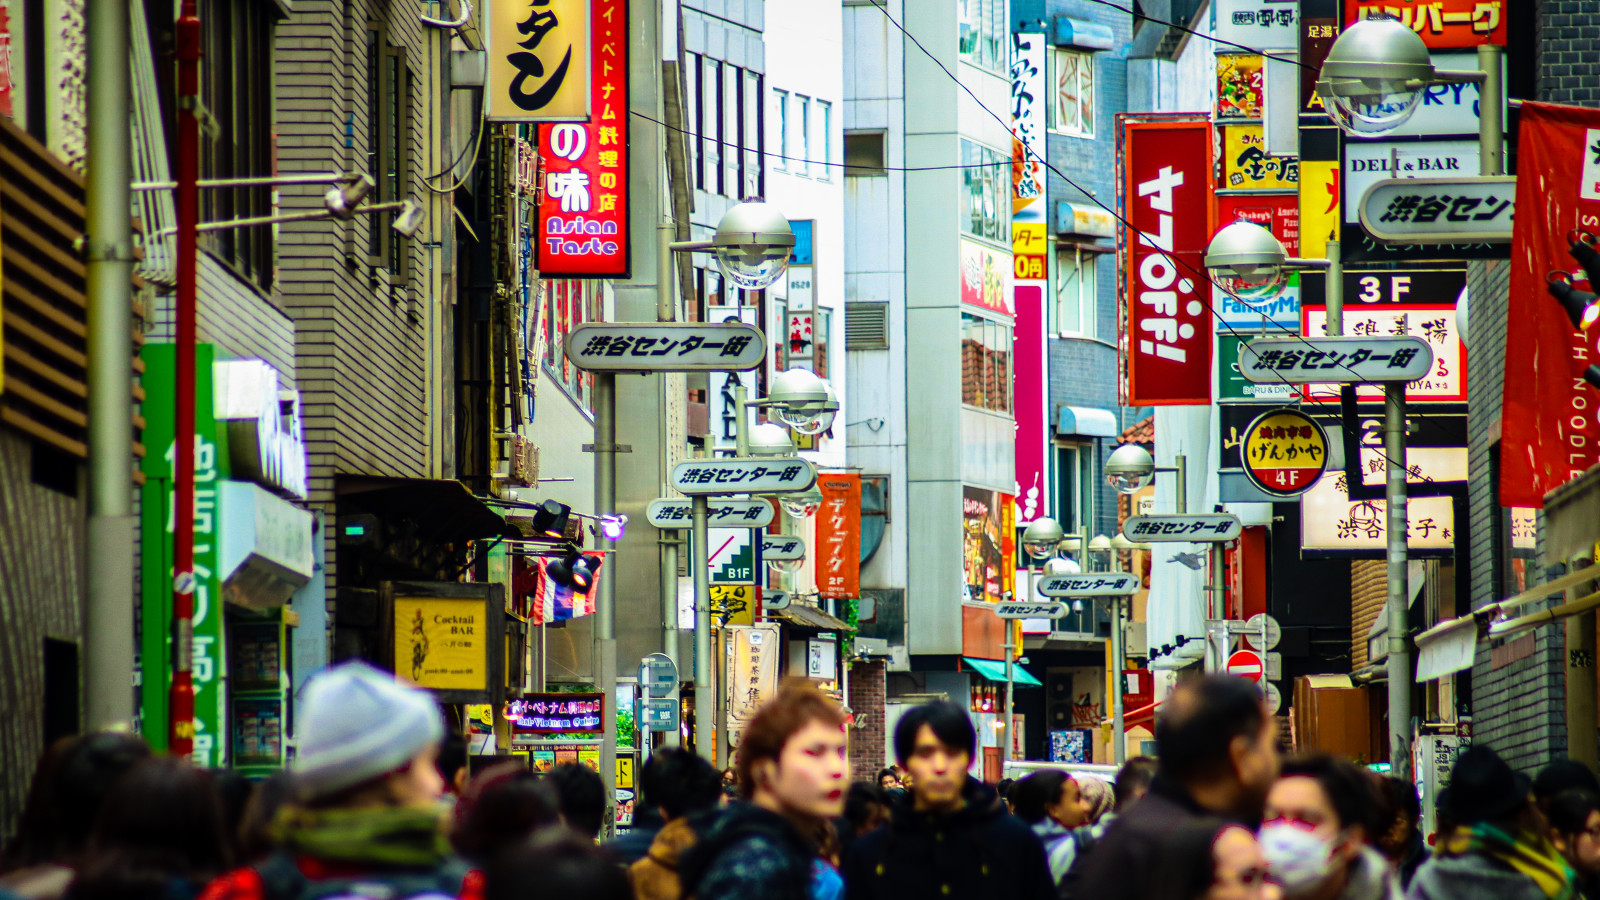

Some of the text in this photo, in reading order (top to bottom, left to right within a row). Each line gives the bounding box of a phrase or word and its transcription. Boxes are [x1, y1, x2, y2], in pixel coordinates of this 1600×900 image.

[506, 0, 572, 111] タン
[597, 0, 619, 212] イ・ベトナム料理の店
[1241, 134, 1264, 145] きん
[1418, 157, 1460, 171] BAR
[1380, 195, 1514, 223] 渋谷セン
[546, 216, 618, 235] Asian
[546, 237, 619, 255] Taste
[1359, 276, 1412, 304] 3F
[581, 335, 752, 357] 渋谷センター街
[1252, 348, 1420, 370] 渋谷センター街
[1406, 380, 1433, 391] UYA
[1251, 442, 1322, 461] げんかや
[679, 466, 802, 484] 渋谷センター街
[1275, 470, 1300, 485] 4F
[656, 506, 765, 520] 渋谷ター街
[1132, 521, 1234, 536] 渋谷センター街
[1336, 518, 1438, 540] 渋谷子
[728, 567, 750, 579] B1F
[828, 576, 845, 585] 2F
[1047, 577, 1128, 592] 渋谷センター街
[997, 605, 1060, 616] 渋谷センター街
[433, 615, 474, 625] Cocktail
[451, 625, 474, 635] BAR
[513, 700, 601, 715] イ・ベトナム料理の店
